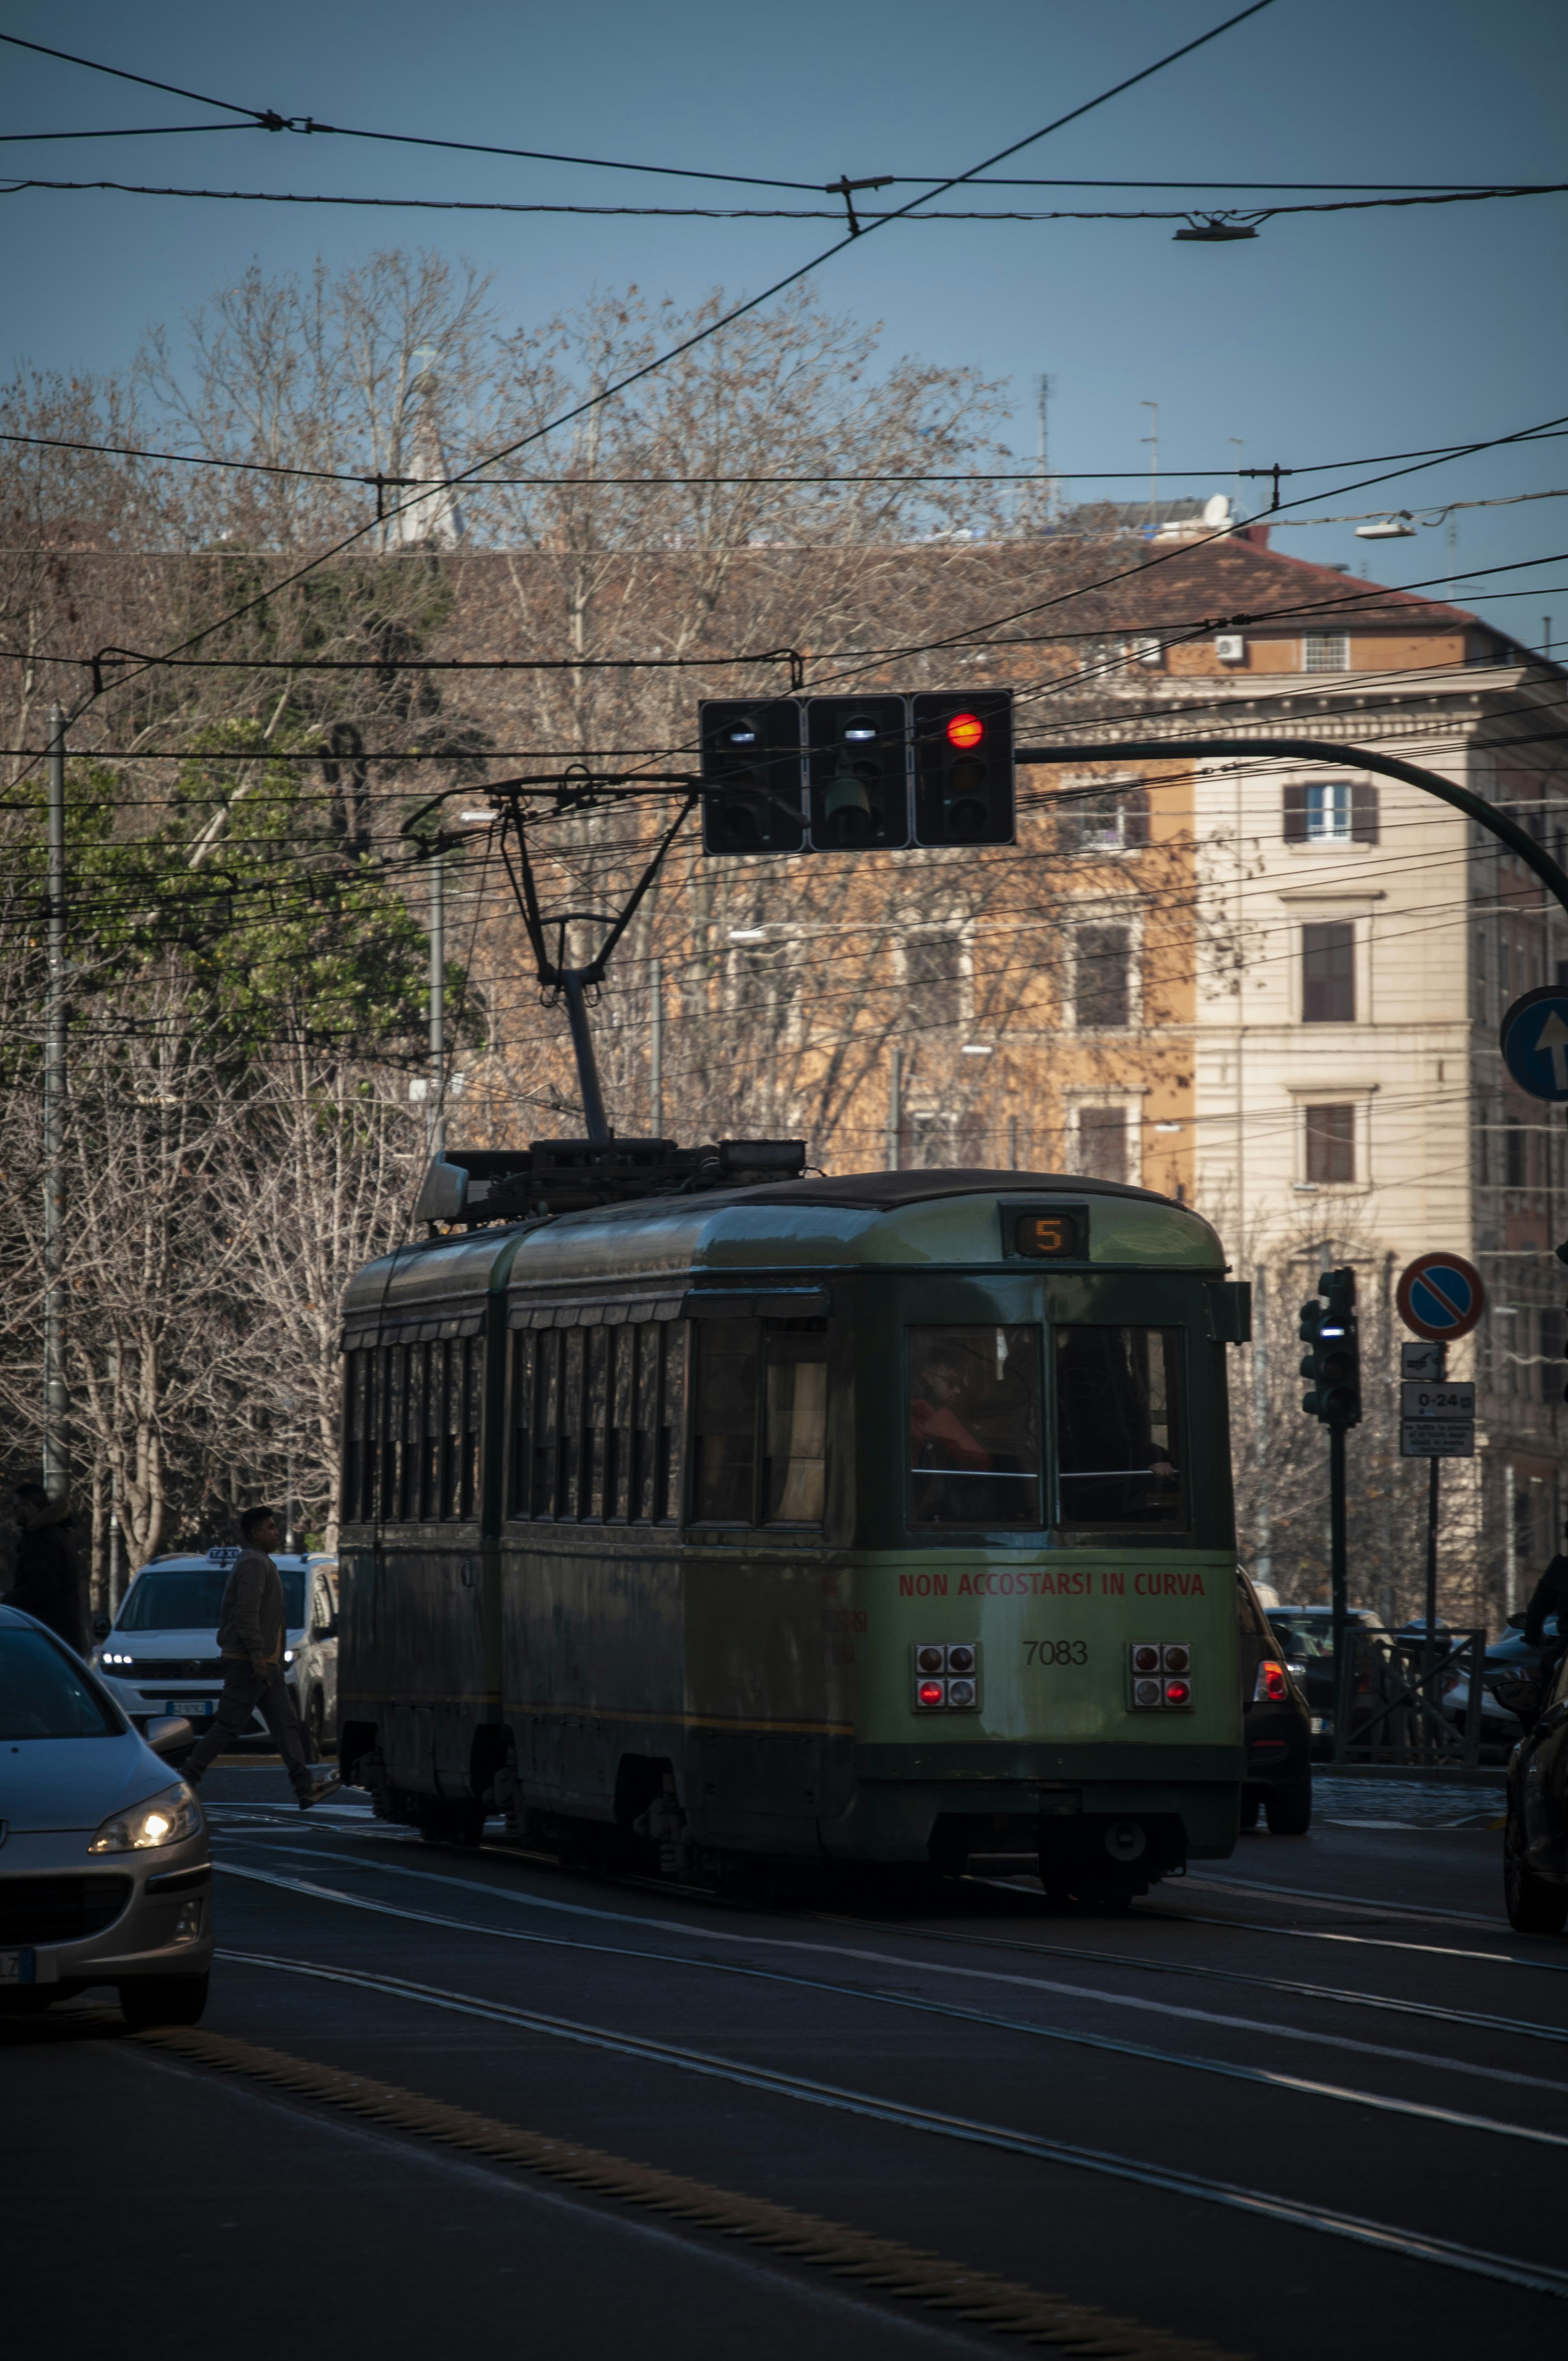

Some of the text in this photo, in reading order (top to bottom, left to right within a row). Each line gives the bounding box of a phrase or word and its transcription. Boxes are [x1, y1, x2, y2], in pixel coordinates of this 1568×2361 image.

[1036, 1220, 1061, 1250] 5
[1418, 1393, 1458, 1407] 0-24
[211, 1550, 238, 1558] TAXI
[899, 1573, 1206, 1597] NON ACCOSTARSI IN CURVA
[1022, 1640, 1088, 1666] 7083
